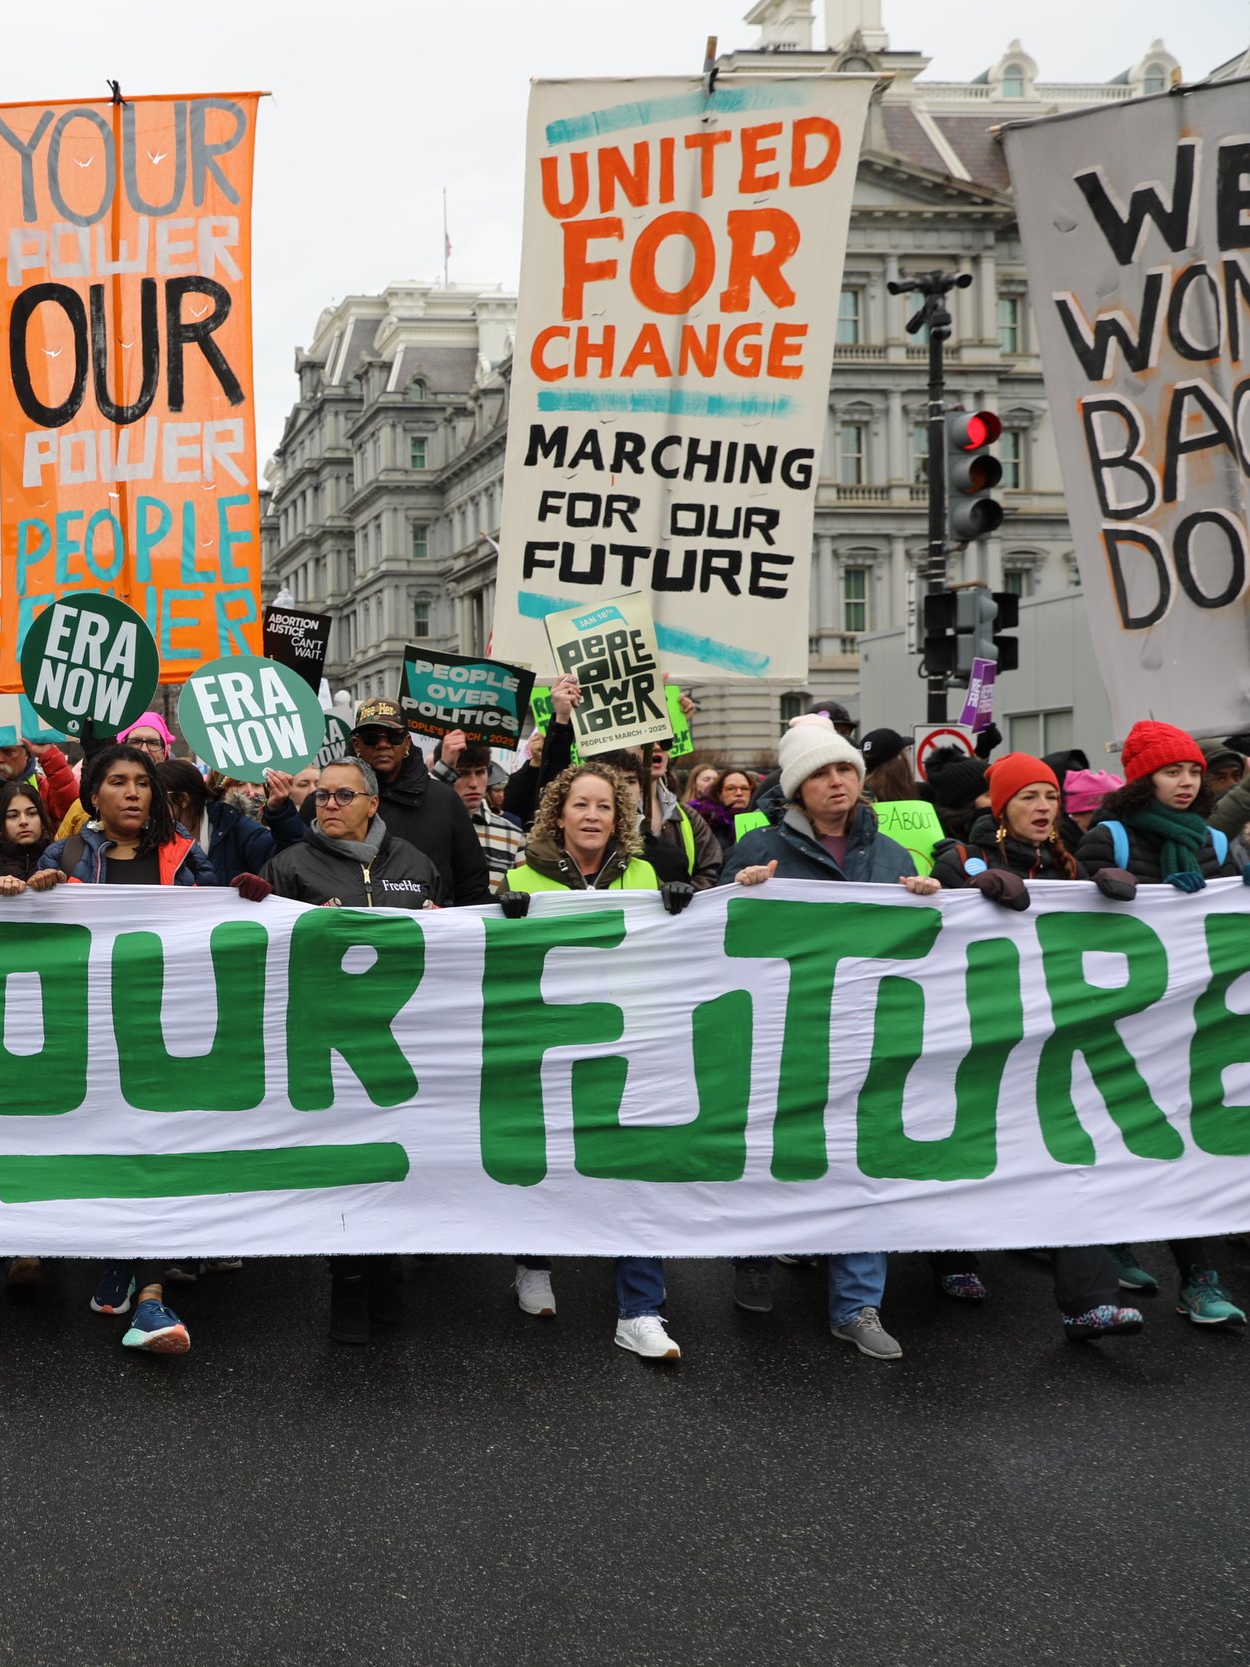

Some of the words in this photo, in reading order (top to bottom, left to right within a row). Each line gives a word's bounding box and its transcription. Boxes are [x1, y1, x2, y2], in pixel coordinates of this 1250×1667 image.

[540, 117, 842, 219] UNITED
[7, 215, 243, 287] POWER
[560, 207, 801, 322] FOR
[9, 275, 246, 428] OUR
[530, 322, 809, 382] CHANGE
[23, 418, 249, 488] POWER
[523, 424, 815, 490] MARCHING
[1078, 378, 1250, 520] BA
[16, 494, 253, 597] PEOPLE
[538, 490, 641, 533] FOR
[670, 503, 780, 546] OUR
[523, 541, 795, 600] FUTURE
[45, 604, 137, 678] ERA
[266, 623, 305, 637] JUSTICE
[268, 613, 319, 630] ABORTION
[291, 636, 323, 650] CAN'T
[580, 616, 597, 628] JAN
[295, 646, 323, 661] WAIT.
[415, 660, 520, 692] PEOPLE
[34, 658, 132, 726] NOW
[190, 667, 299, 724] ERA
[401, 696, 519, 731] POLITICS
[427, 684, 499, 706] OVER
[206, 713, 309, 769] NOW
[408, 719, 444, 736] EOPLE'S
[580, 735, 613, 747] PEOPLE'S
[615, 728, 642, 740] MARCH
[648, 723, 667, 734] 2025
[889, 806, 936, 831] ABOUT
